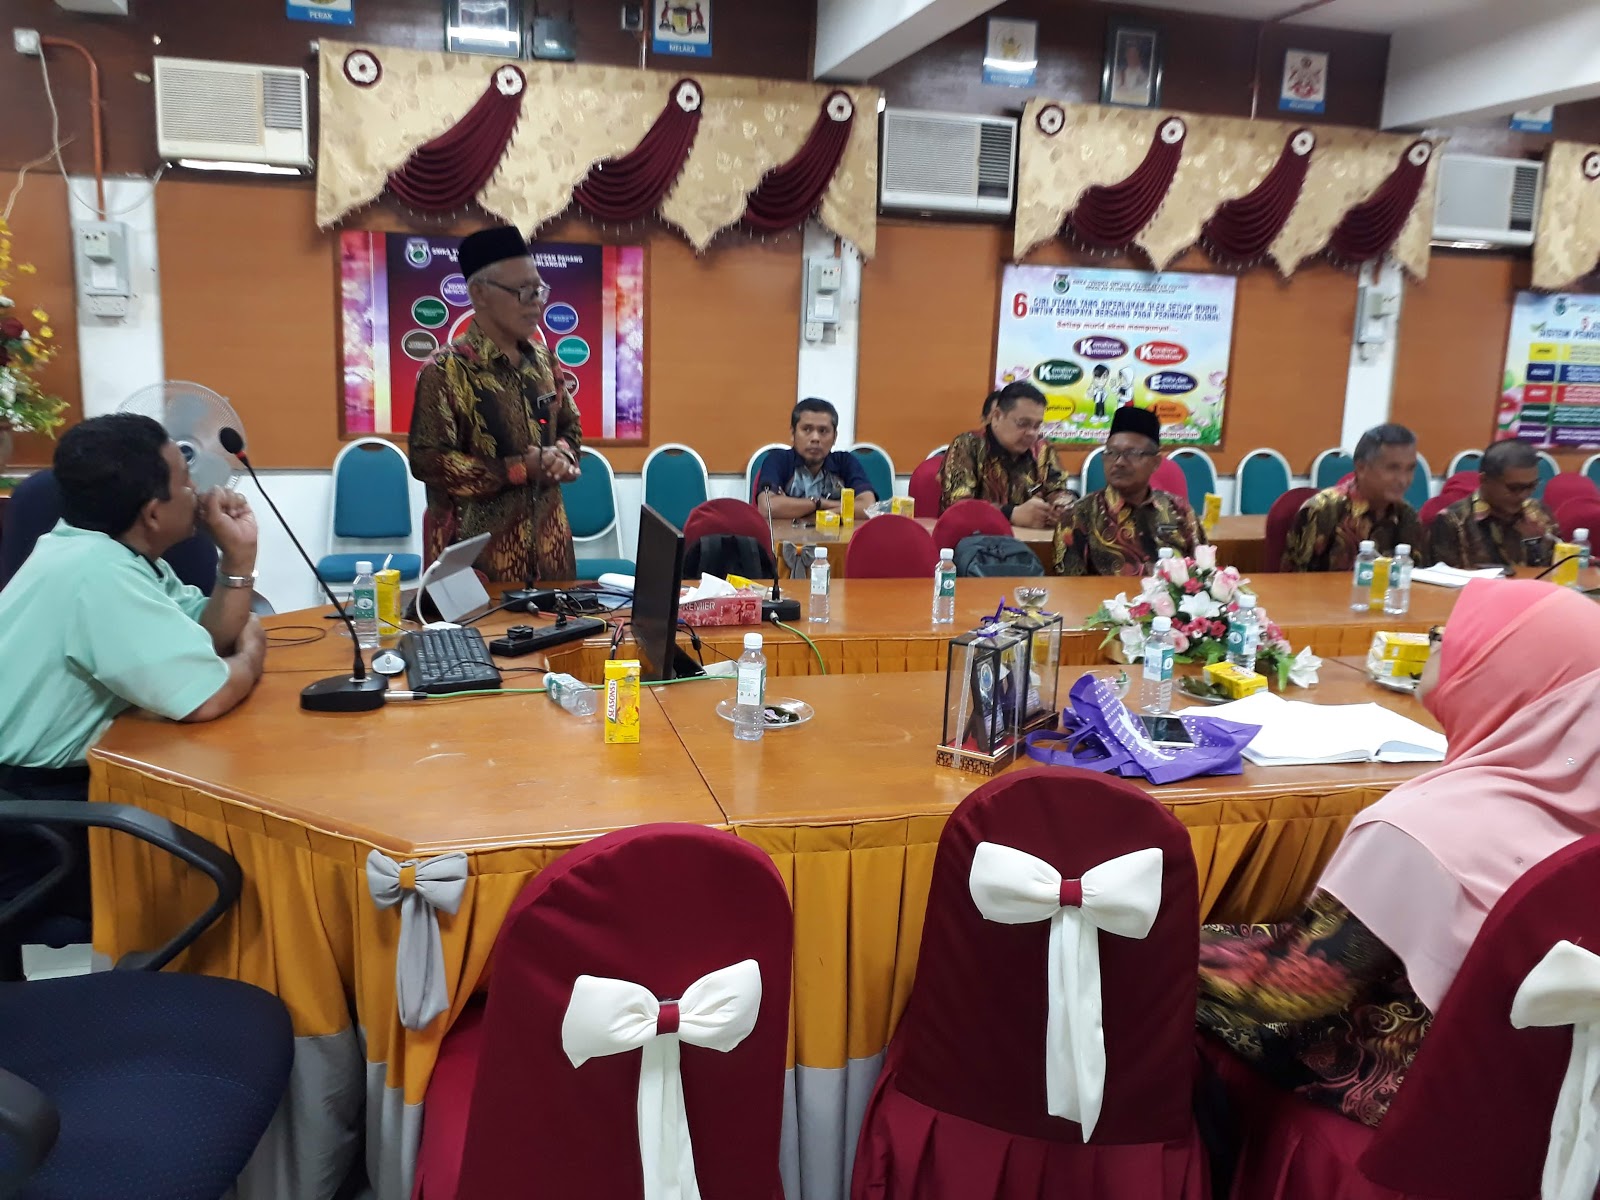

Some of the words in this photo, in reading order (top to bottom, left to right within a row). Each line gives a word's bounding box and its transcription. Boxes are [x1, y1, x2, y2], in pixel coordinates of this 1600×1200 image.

[309, 11, 333, 20] PERAK
[1013, 293, 1027, 317] 6
[1051, 298, 1077, 308] UTAMA
[1080, 299, 1098, 309] YANG
[1101, 300, 1145, 311] DIPERLUKAN
[1148, 302, 1165, 311] OLEH
[1168, 303, 1192, 312] SETIAP
[1030, 307, 1053, 316] UNTUK
[1056, 308, 1093, 317] BERUPAYA
[1095, 309, 1130, 318] BERSAING
[1133, 311, 1151, 319] PADA
[1154, 311, 1192, 320] PERINGKAT
[1056, 321, 1081, 330] Setiap
[1083, 322, 1105, 330] murid
[682, 601, 717, 611] REMIER
[607, 686, 616, 717] SEASONS
